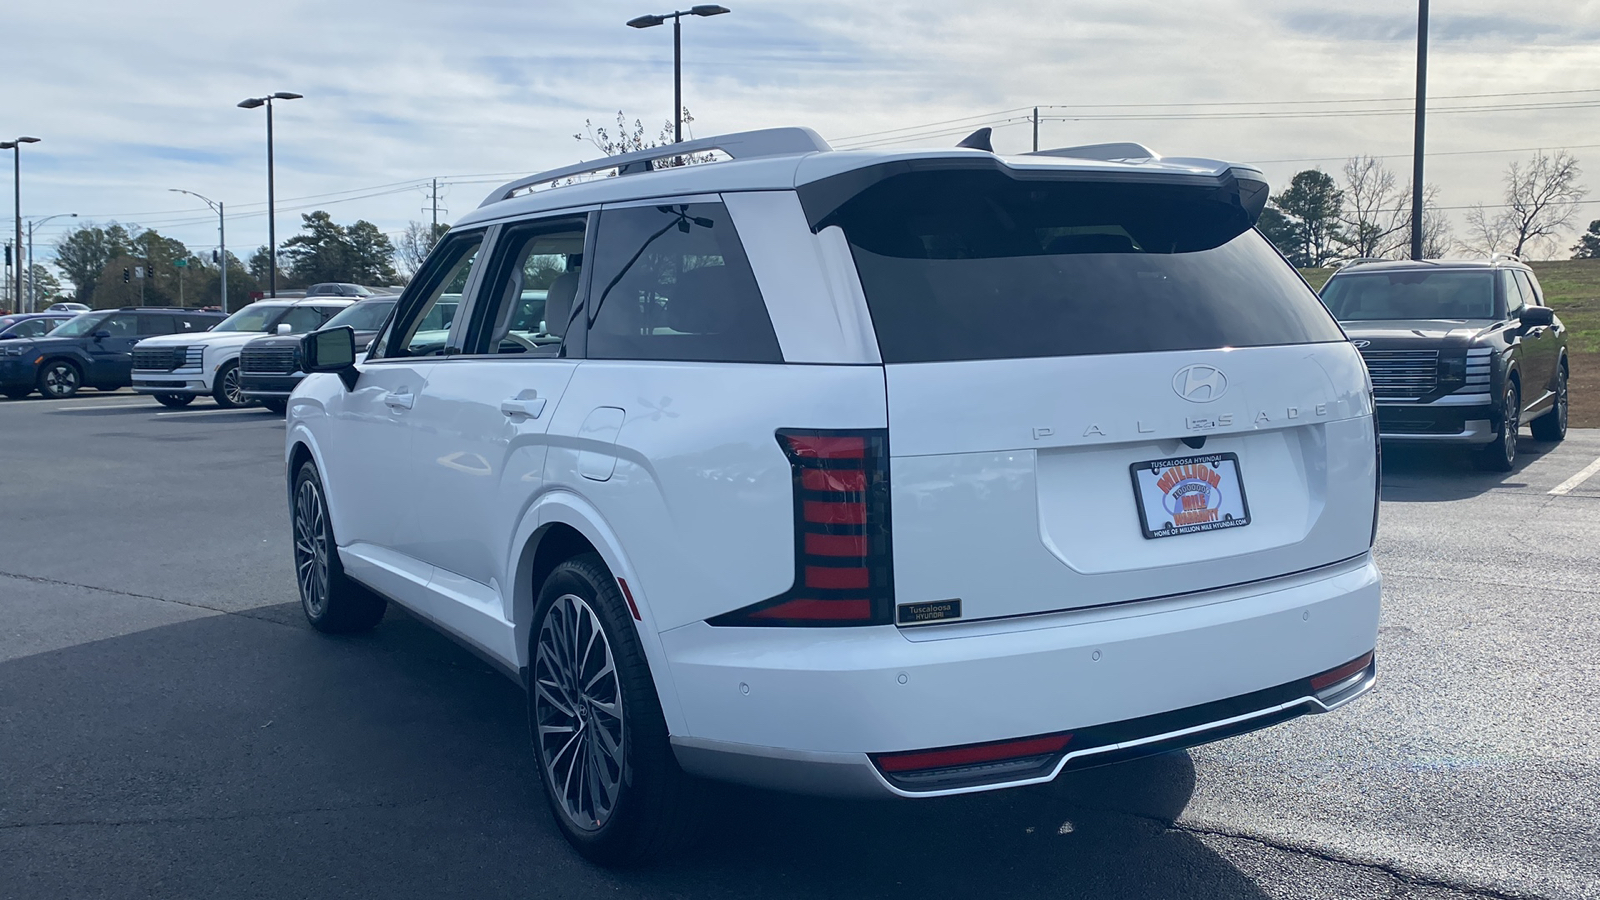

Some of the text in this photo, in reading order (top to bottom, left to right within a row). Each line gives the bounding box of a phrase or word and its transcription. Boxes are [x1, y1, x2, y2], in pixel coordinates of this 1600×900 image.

[1032, 402, 1328, 440] PALISADE
[1151, 455, 1222, 469] TUSCALOOSA HYUNDAI
[1156, 464, 1221, 495] MILLION
[1181, 493, 1207, 510] MILE
[1173, 508, 1219, 526] WARRANTY
[1154, 519, 1246, 537] HOME OF MILLION MILE HYUNDAI.COM
[909, 604, 951, 614] Tuscaloosa
[915, 611, 944, 620] HYUNDAI
